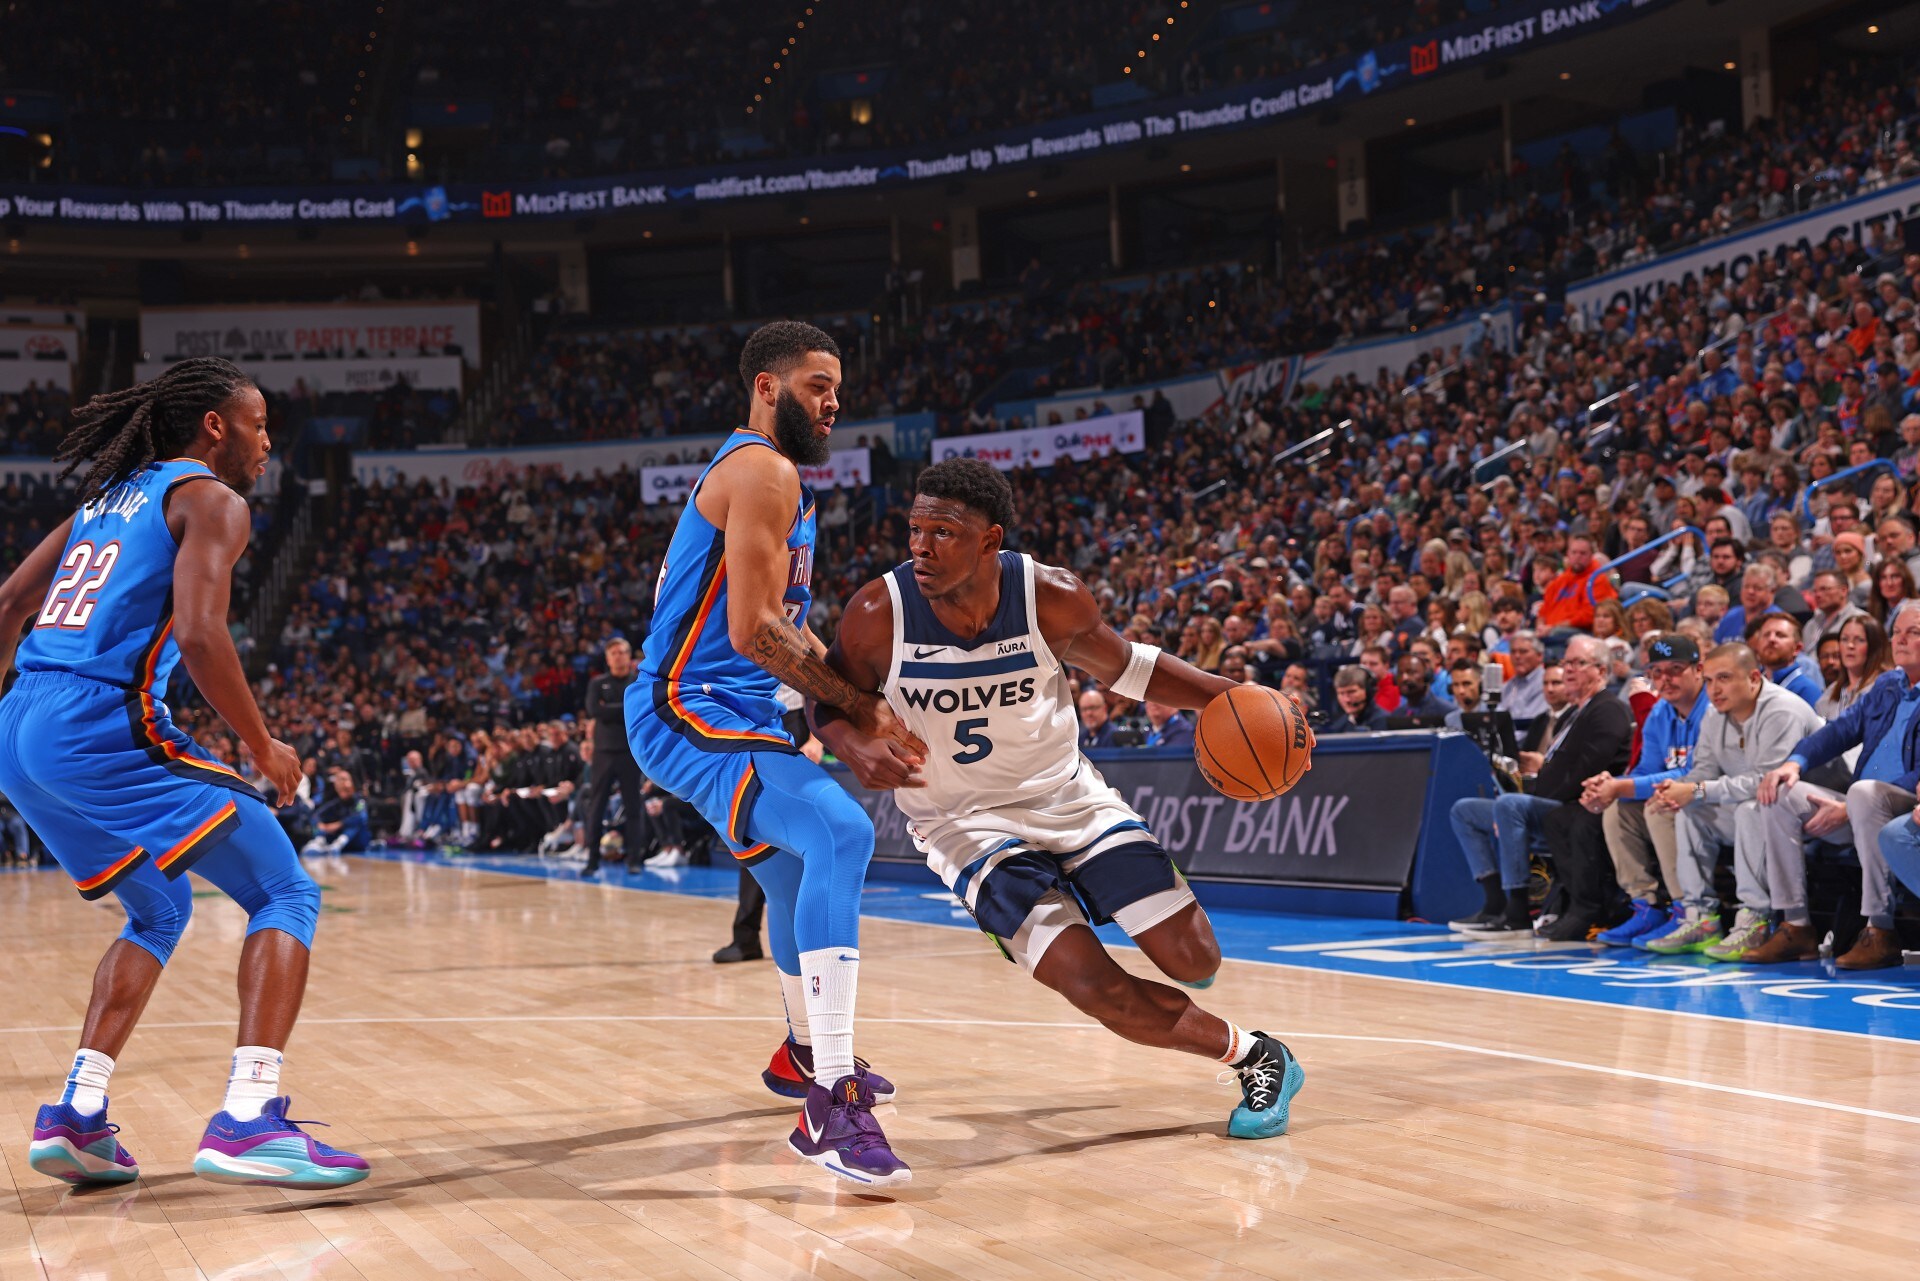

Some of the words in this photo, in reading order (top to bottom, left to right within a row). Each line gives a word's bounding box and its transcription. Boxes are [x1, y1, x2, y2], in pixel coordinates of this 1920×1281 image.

[1541, 1, 1601, 34] BANK
[906, 154, 969, 179] Thunder
[970, 149, 993, 170] Up
[994, 143, 1029, 164] Your
[1031, 129, 1102, 157] Rewards
[1103, 120, 1142, 145] With
[1144, 116, 1176, 137] The
[1177, 103, 1248, 131] Thunder
[1249, 89, 1297, 119] Credit
[1298, 77, 1335, 106] Card
[14, 195, 56, 217] Your
[60, 198, 141, 221] Rewards
[143, 201, 185, 221] With
[187, 201, 222, 220] The
[223, 200, 295, 220] Thunder
[299, 199, 351, 219] Credit
[353, 198, 396, 218] Card
[612, 185, 667, 207] BANK
[176, 331, 223, 350] POST
[252, 330, 287, 348] OAK
[295, 327, 359, 350] PARTY
[367, 325, 455, 347] TERRACE
[34, 539, 121, 630] 22
[900, 677, 1036, 714] WOLVES
[951, 718, 994, 765] 5
[1223, 794, 1350, 857] BANK
